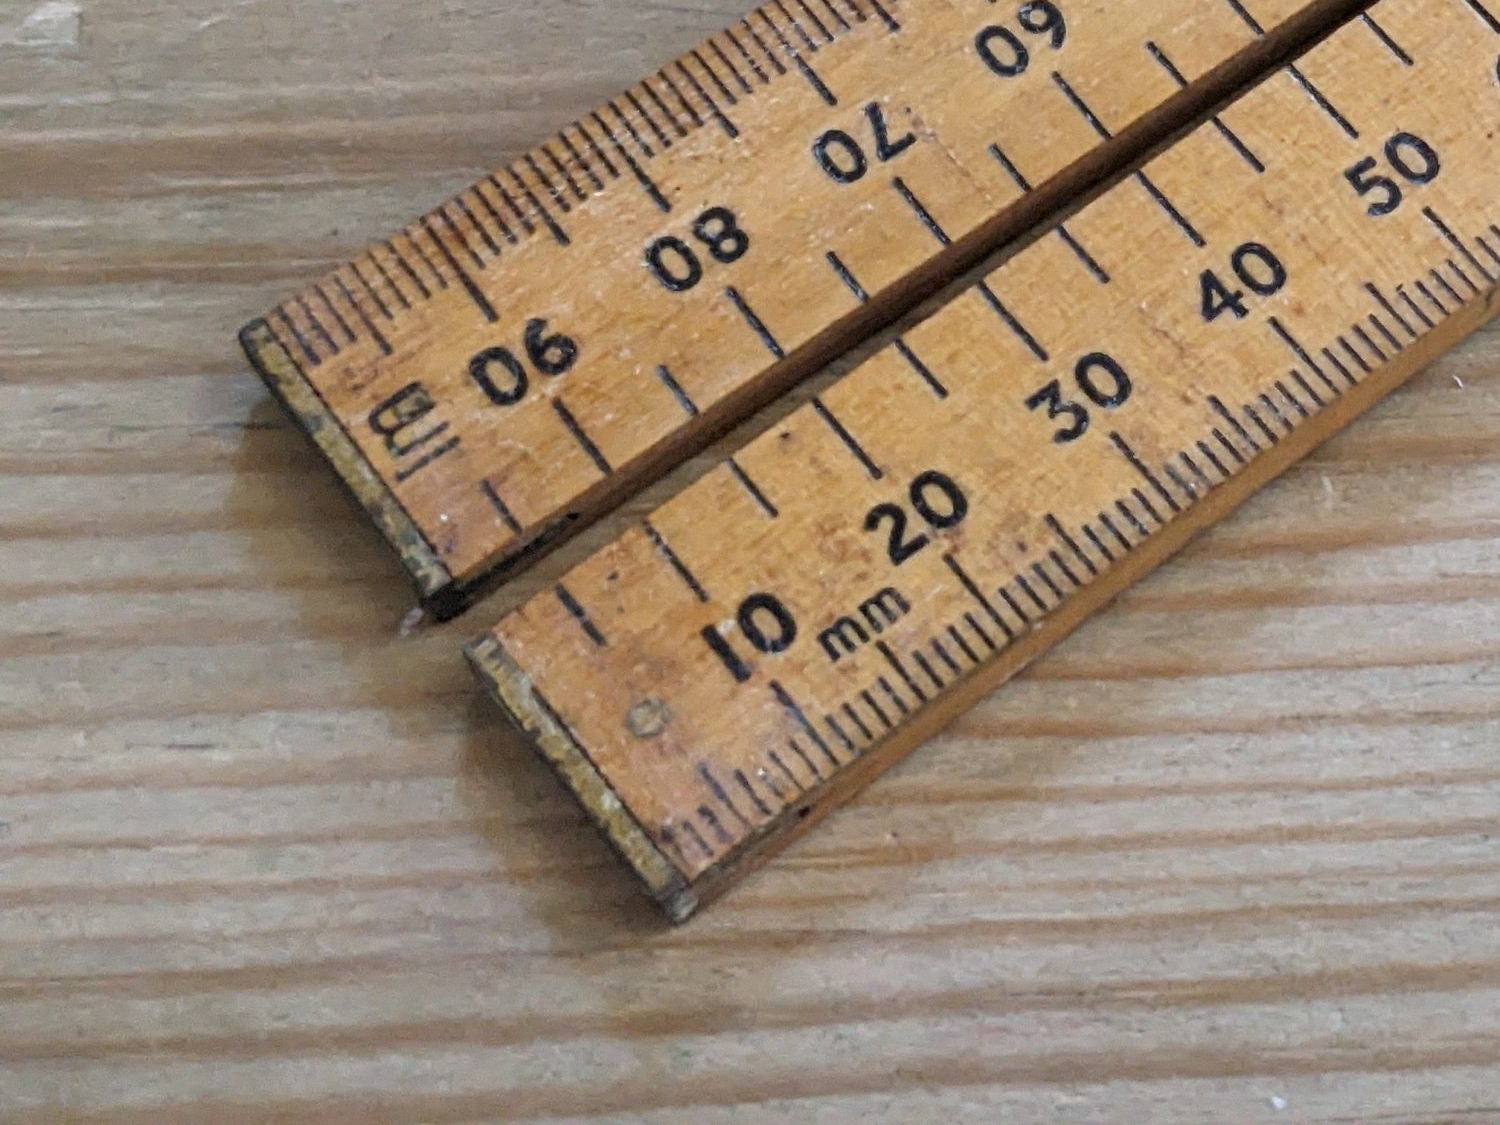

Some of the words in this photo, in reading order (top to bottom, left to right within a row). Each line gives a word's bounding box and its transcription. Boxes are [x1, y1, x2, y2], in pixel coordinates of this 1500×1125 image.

[811, 101, 917, 184] 70
[644, 206, 750, 292] 80
[466, 317, 578, 407] 90
[701, 592, 797, 681] 10
[864, 470, 968, 565] 20
[1024, 351, 1132, 445] 30
[1199, 242, 1287, 324] 40
[1344, 131, 1439, 217] 50
[814, 585, 912, 662] mm
